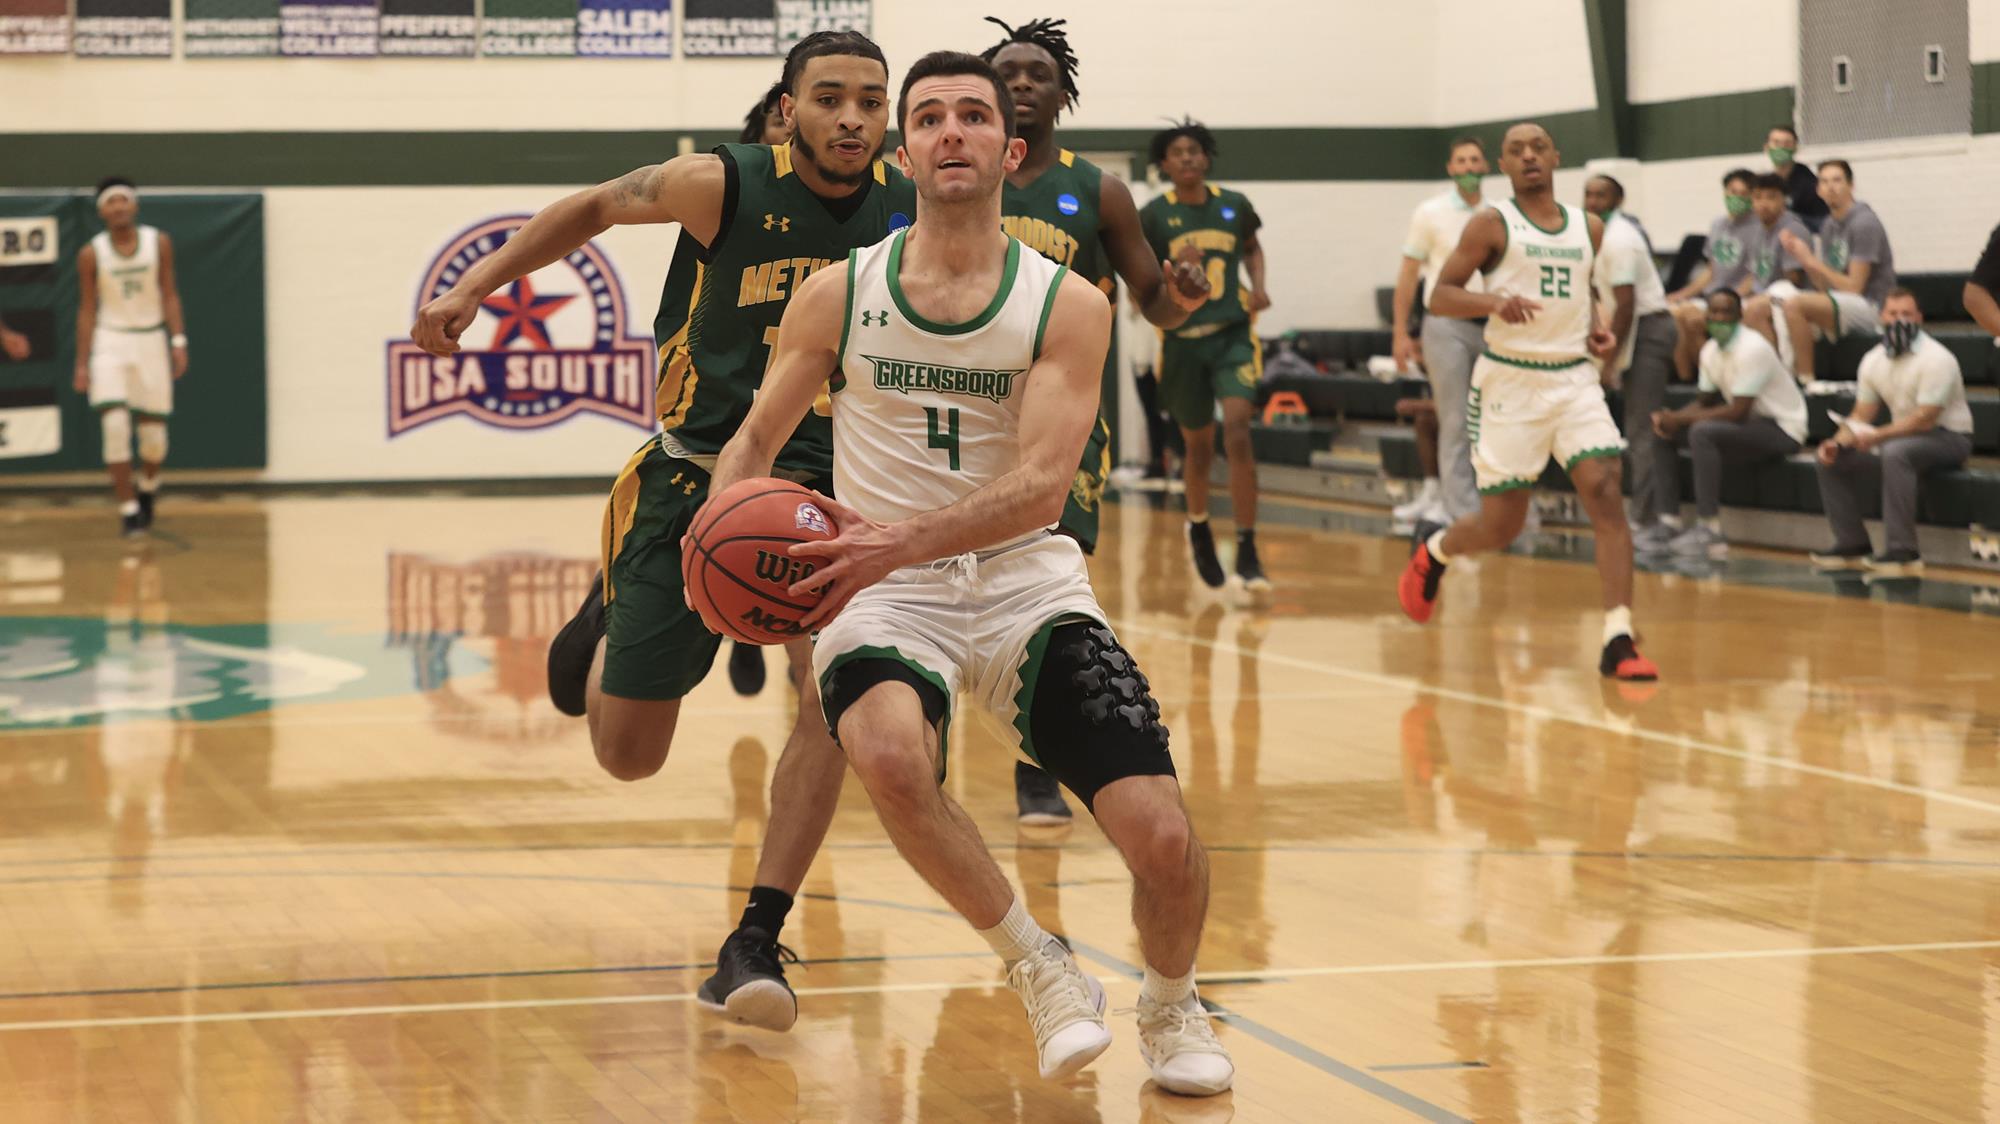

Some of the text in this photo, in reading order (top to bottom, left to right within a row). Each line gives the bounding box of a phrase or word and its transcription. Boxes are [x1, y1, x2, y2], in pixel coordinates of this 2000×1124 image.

[380, 16, 475, 36] PFEIFFER
[482, 18, 575, 34] PIEDMONT
[578, 9, 671, 36] SALEM
[75, 36, 171, 55] COLLEGE
[281, 36, 376, 55] COLLEGE
[482, 35, 575, 55] COLLEGE
[578, 36, 670, 55] COLLEGE
[683, 35, 775, 54] COLLEGE
[1540, 265, 1570, 299] 22
[403, 354, 641, 411] USA SOUTH
[867, 355, 1022, 403] GREENSBORO
[922, 407, 961, 471] 4
